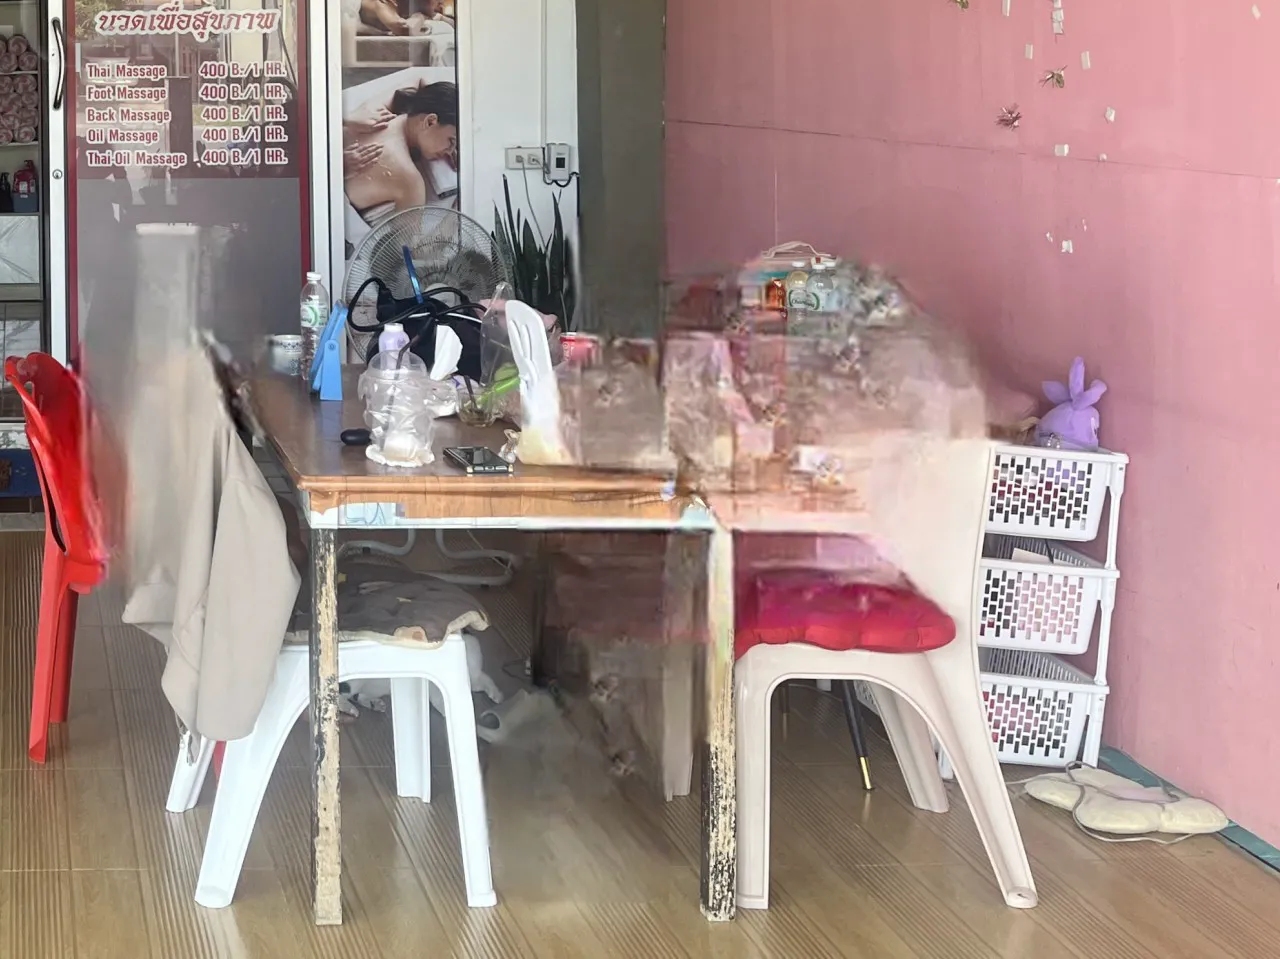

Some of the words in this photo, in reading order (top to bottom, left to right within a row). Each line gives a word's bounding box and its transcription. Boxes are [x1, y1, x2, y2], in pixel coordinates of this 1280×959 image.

[98, 0, 278, 39] นวดเพื่อสุขภาพ
[87, 64, 111, 78] Thai
[116, 64, 166, 79] Massage
[200, 63, 226, 77] 400
[87, 86, 112, 100] Foot
[117, 86, 167, 101] Massage
[200, 85, 227, 100] 400
[87, 108, 115, 122] Back
[120, 108, 170, 123] Massage
[202, 107, 227, 121] 400
[88, 129, 103, 142] Oil
[109, 129, 158, 144] Massage
[202, 128, 227, 142] 400
[136, 151, 186, 167] Massage
[203, 150, 227, 164] 400
